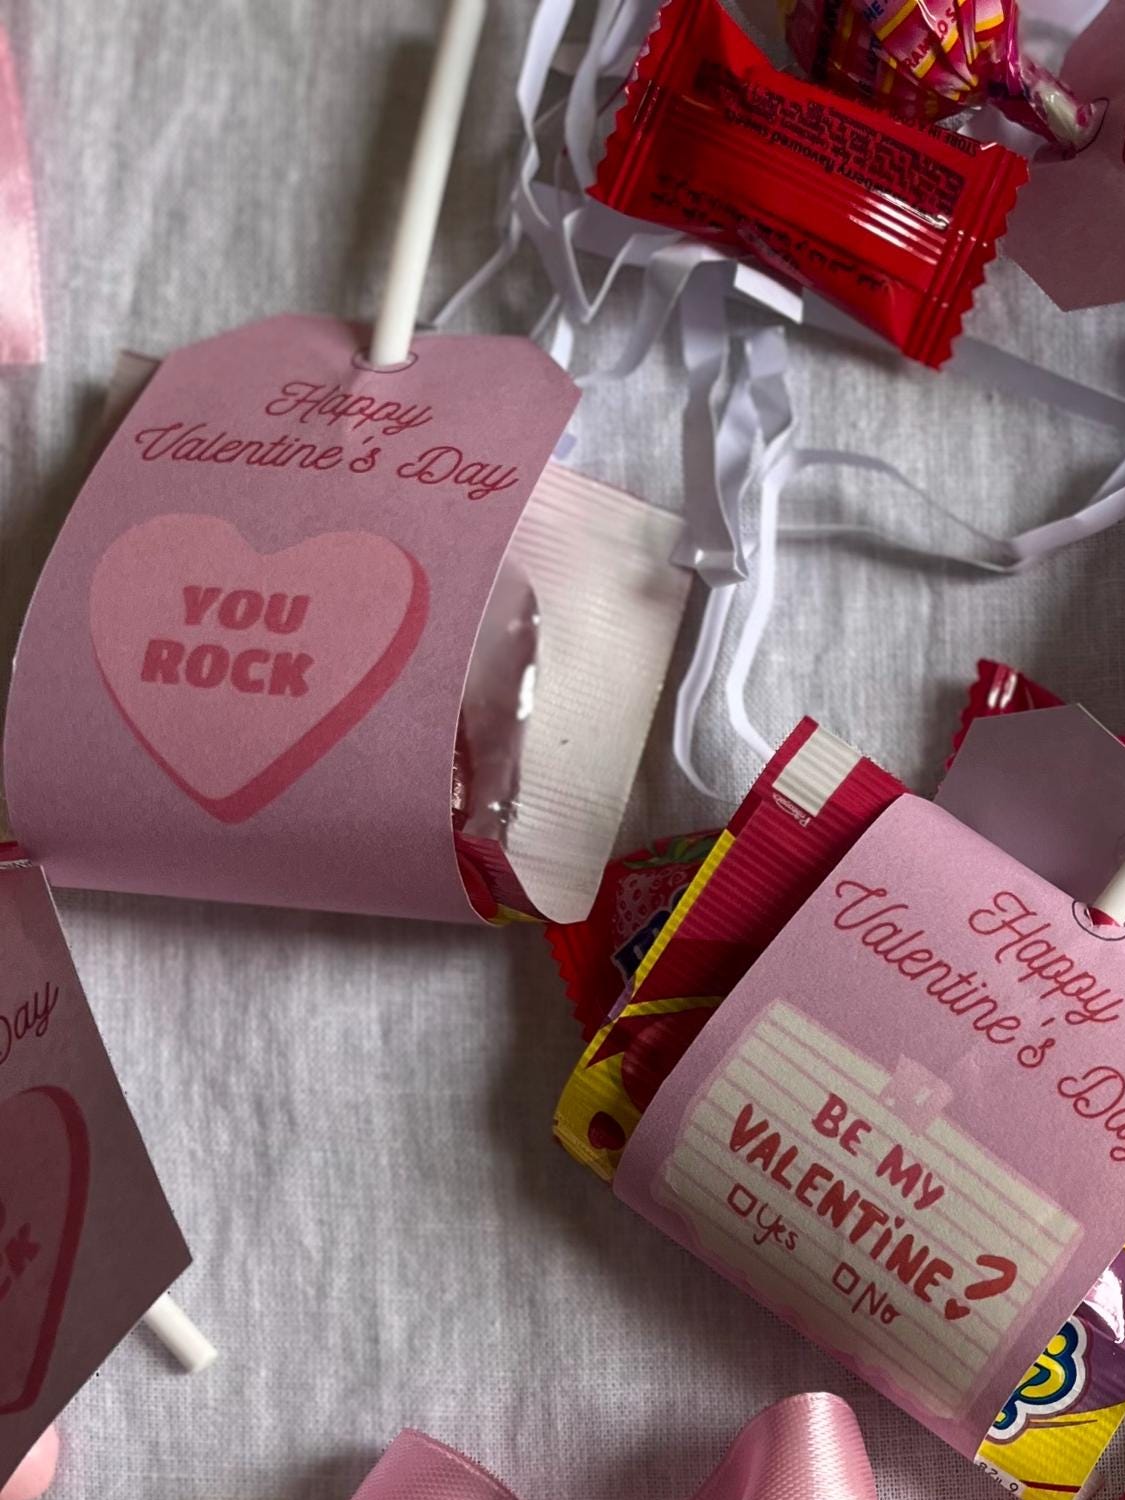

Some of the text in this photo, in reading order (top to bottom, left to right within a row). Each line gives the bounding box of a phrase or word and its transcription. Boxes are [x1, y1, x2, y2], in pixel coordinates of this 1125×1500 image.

[265, 381, 433, 434] Happy
[135, 423, 520, 500] Valentine's Day
[181, 586, 310, 633] YOU
[140, 639, 314, 698] ROCK
[835, 879, 1056, 1069] Valentine's
[969, 891, 1124, 1024] Happy
[812, 1093, 946, 1211] BE MY
